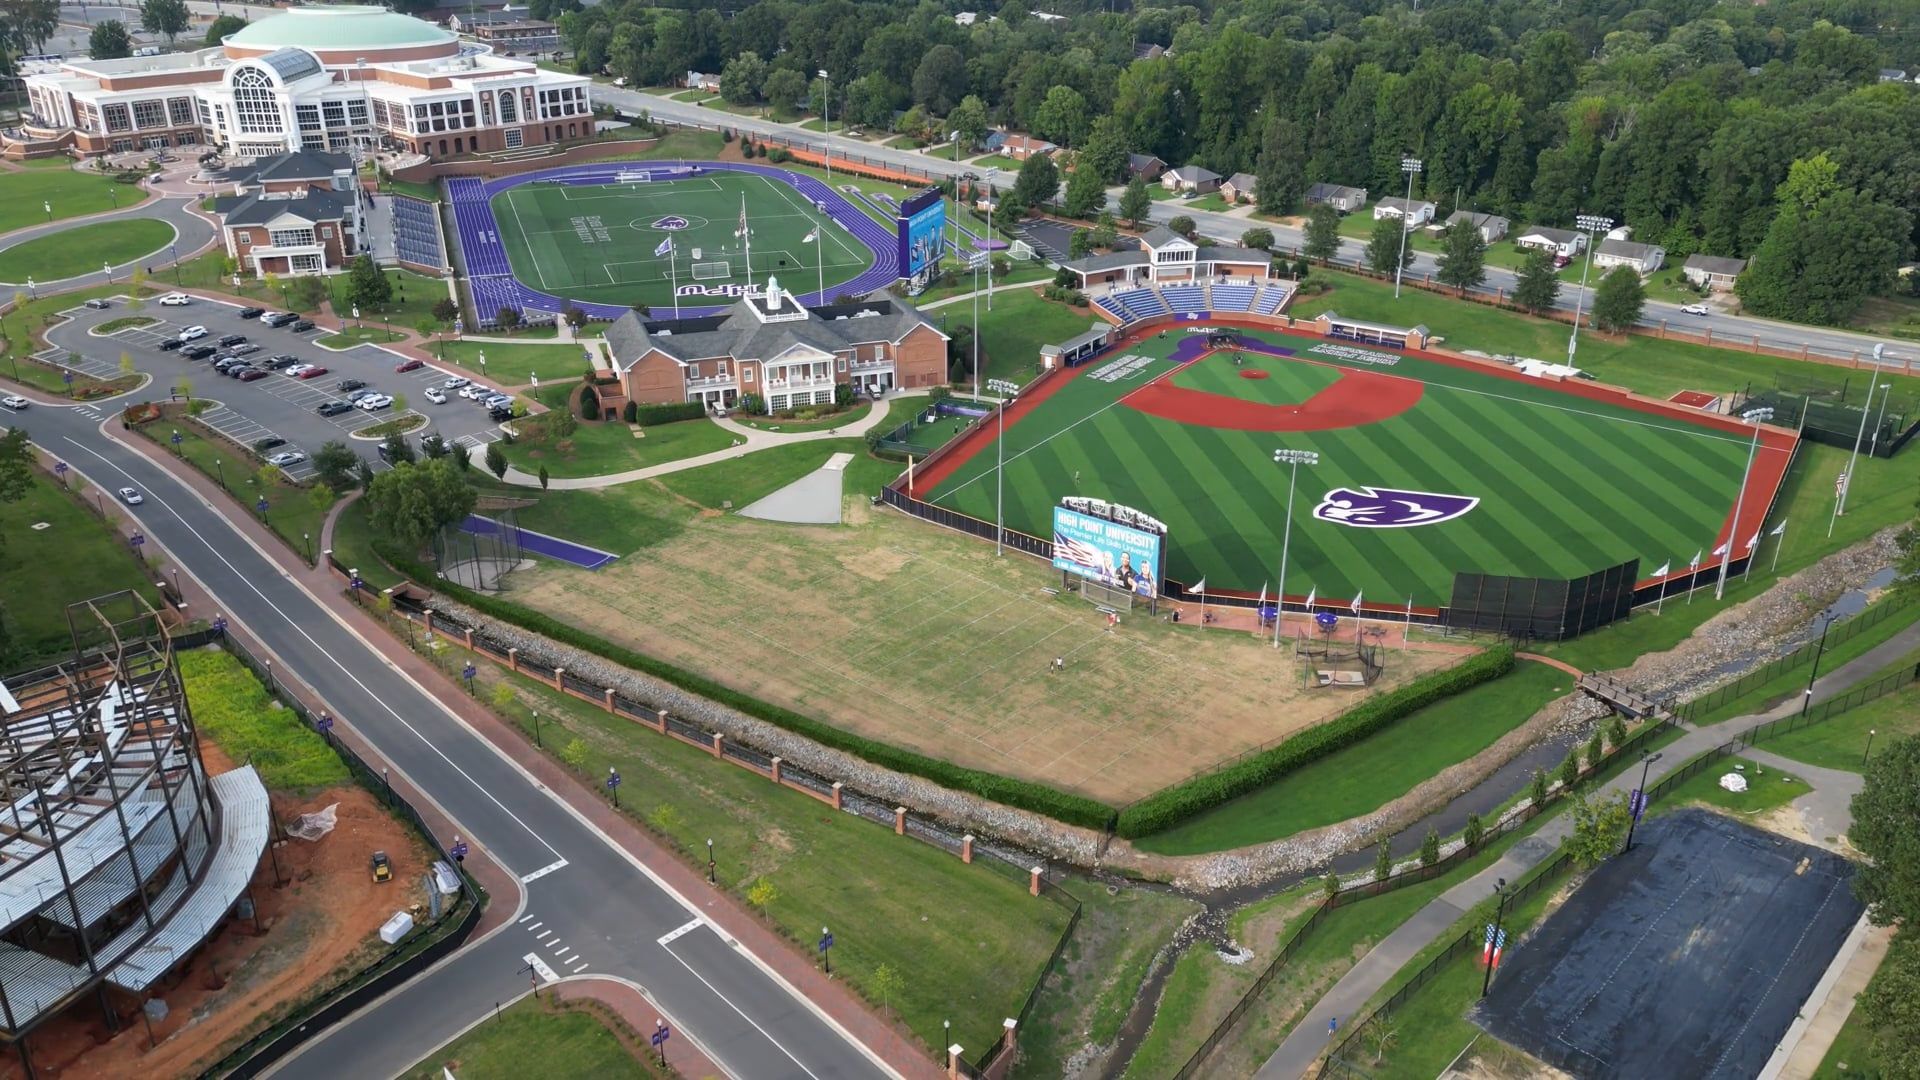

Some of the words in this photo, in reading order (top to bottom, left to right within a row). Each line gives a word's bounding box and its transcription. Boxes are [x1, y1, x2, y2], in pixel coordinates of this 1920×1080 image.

[676, 284, 762, 297] HPU
[1057, 511, 1078, 529] HIGH
[1079, 517, 1104, 535] POINT
[1105, 524, 1156, 550] UNIVERSITY
